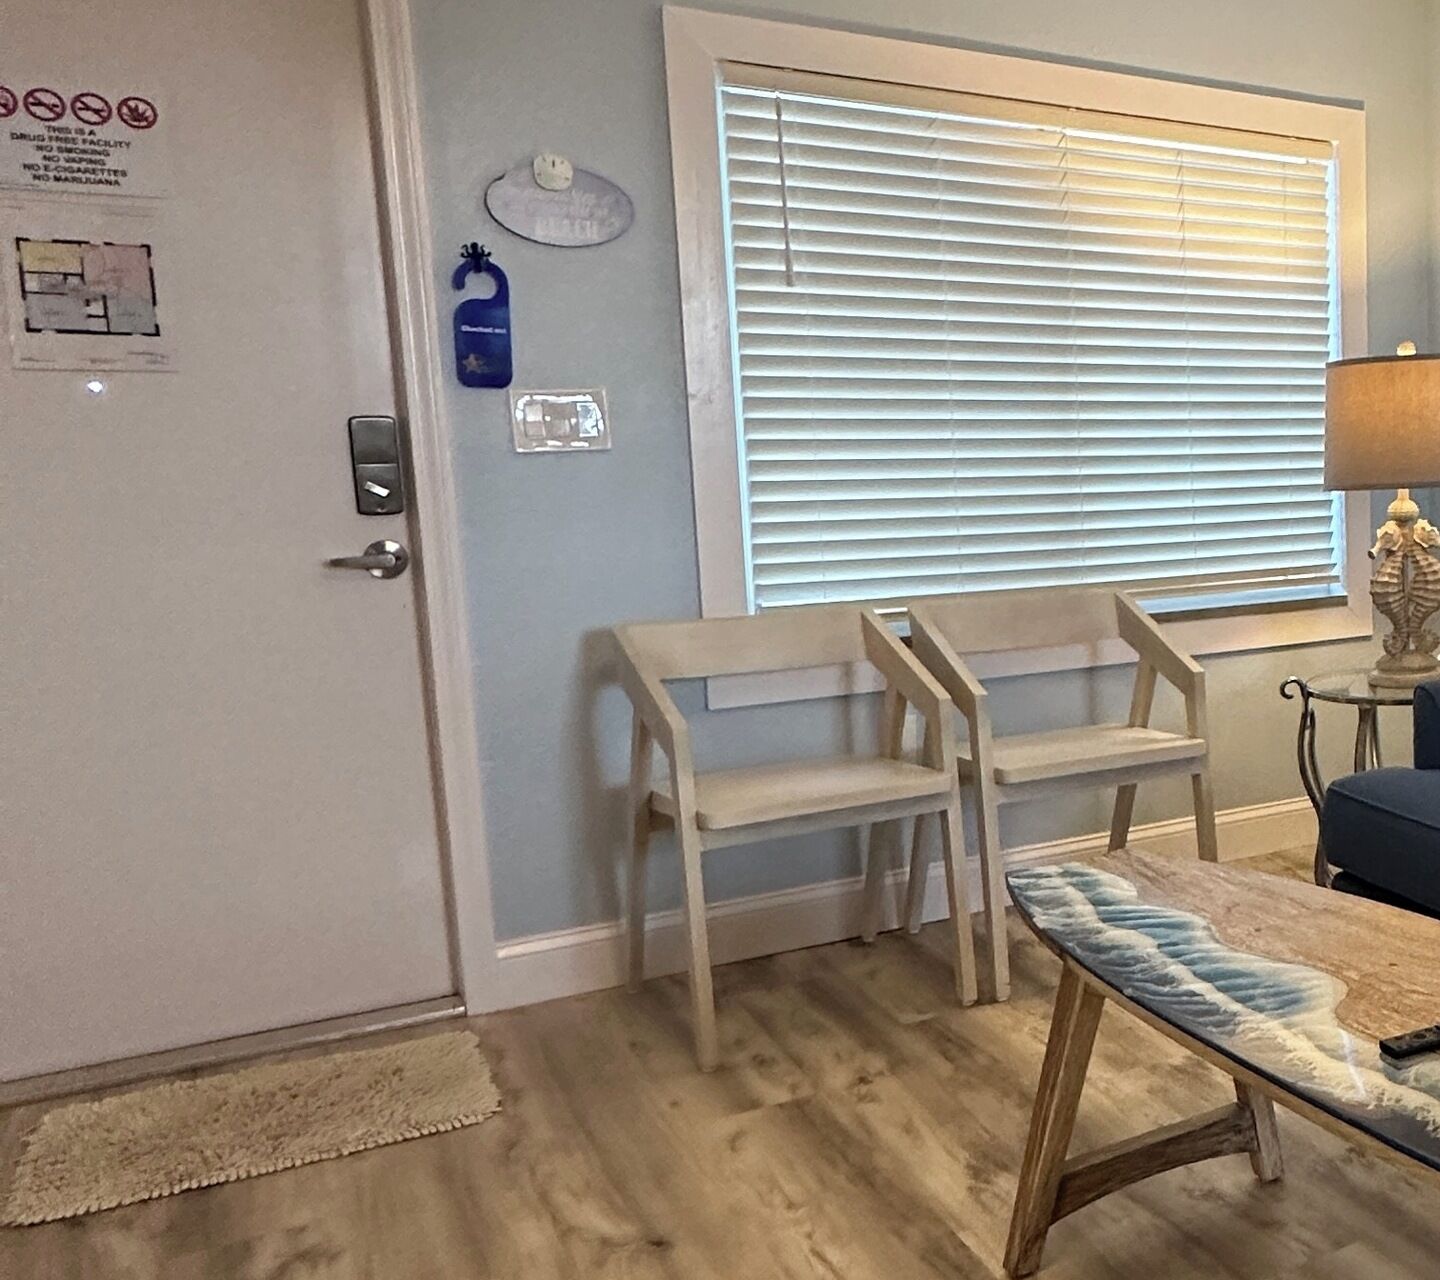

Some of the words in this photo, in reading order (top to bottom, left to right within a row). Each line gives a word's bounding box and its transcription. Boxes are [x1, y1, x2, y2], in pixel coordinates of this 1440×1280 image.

[46, 125, 72, 135] THIS
[74, 127, 86, 136] IS
[88, 129, 97, 137] A
[10, 131, 46, 142] DRUG
[48, 135, 79, 145] FREE
[82, 138, 131, 149] FACILITY
[35, 144, 53, 153] NO
[57, 146, 110, 157] SMOKING
[42, 154, 60, 163] NO
[63, 155, 106, 166] VAPING
[23, 163, 41, 172] NO
[43, 164, 128, 178] E-CIGARETTES
[32, 173, 50, 182] NO
[53, 175, 121, 187] MARIJUANA
